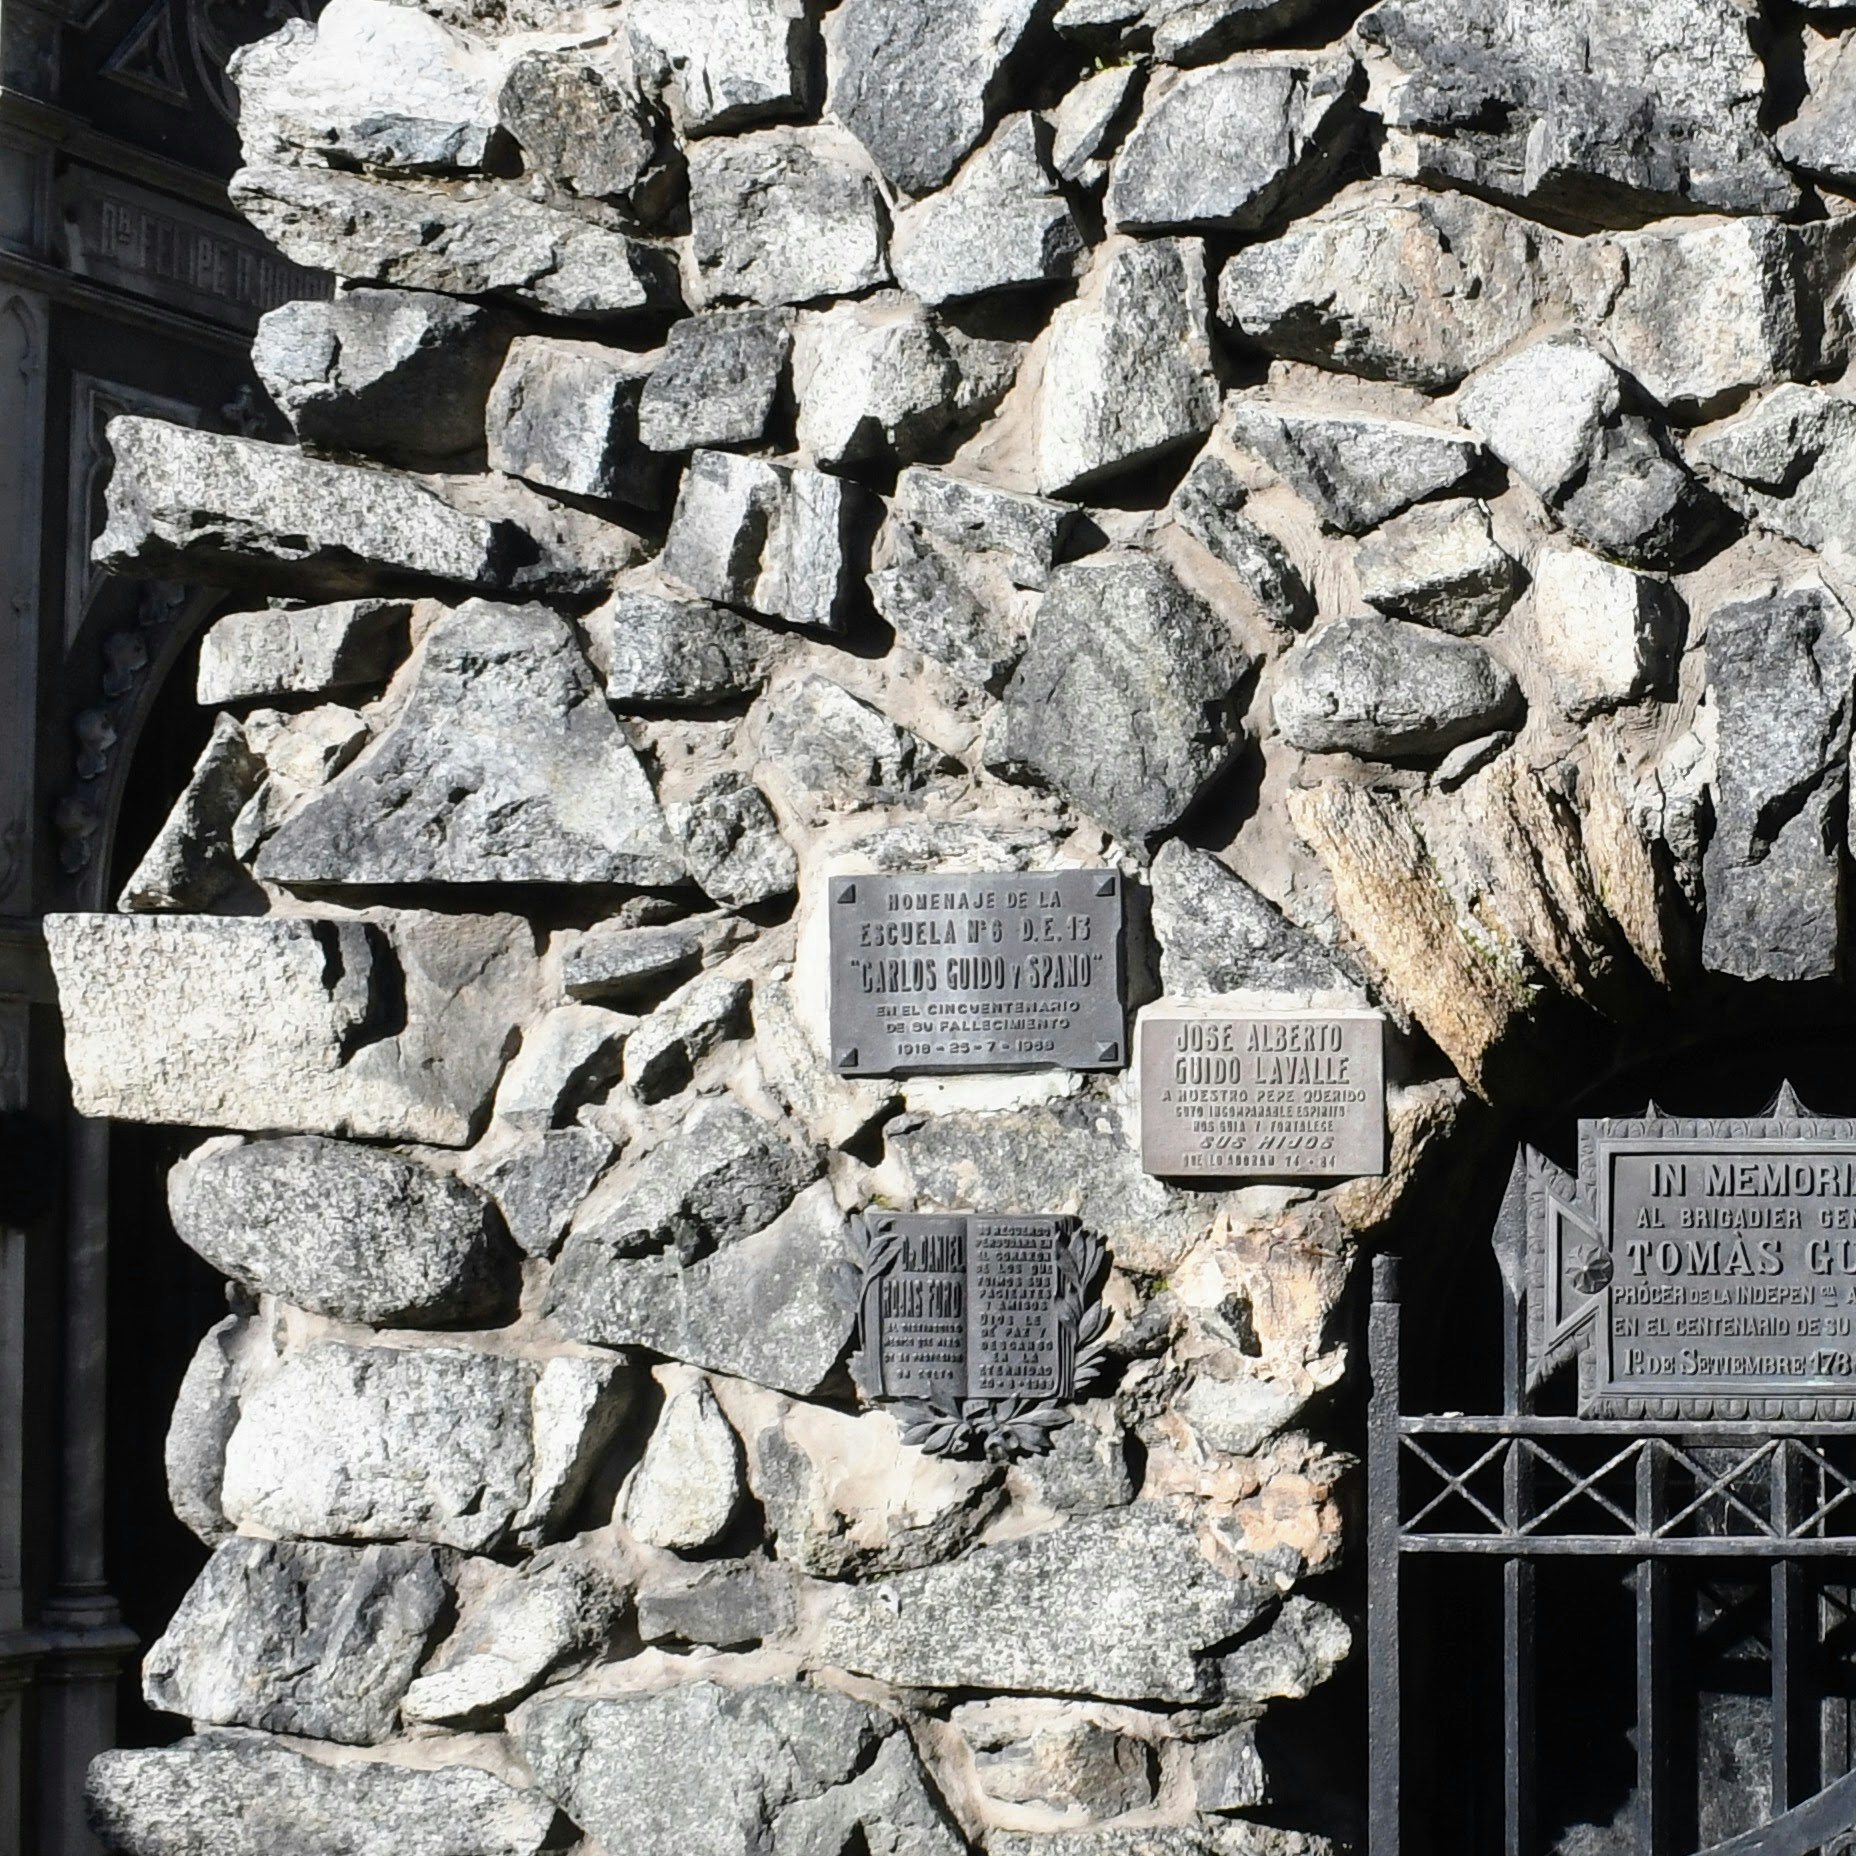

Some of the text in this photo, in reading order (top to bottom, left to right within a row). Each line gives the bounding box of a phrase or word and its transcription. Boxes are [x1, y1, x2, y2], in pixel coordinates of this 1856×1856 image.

[887, 891, 1062, 912] HOMENAJE DE LA
[859, 919, 957, 947] ESCUELA
[946, 955, 1006, 991] GUIDO
[876, 1000, 1081, 1018] EN EL CINCUENTENARIO
[886, 1017, 1071, 1034] DE SU FALLECIMIENTO
[1176, 1022, 1344, 1053] JOSE ALBERTO
[897, 1042, 931, 1056] 1918
[986, 1040, 997, 1053] 7
[1175, 1055, 1352, 1086] GUIDO LAVALLE
[1161, 1089, 1367, 1104] A NUESTRO PEPE QUERIDO
[1175, 1105, 1204, 1119] CUYO
[1209, 1105, 1294, 1119] INCOMPARABLE
[1193, 1120, 1216, 1133] NOS
[1270, 1120, 1335, 1133] FORTALECE
[1200, 1135, 1336, 1151] SUS HIJOS
[1183, 1154, 1203, 1168] QUE
[1209, 1154, 1223, 1167] LO
[1227, 1154, 1276, 1168] ADORAN
[1649, 1162, 1687, 1198] IN
[1636, 1208, 1666, 1229] AL
[1679, 1208, 1802, 1230] BRIGADIER
[920, 1234, 966, 1274] DANIEL
[1625, 1231, 1785, 1277] TOMÁS
[1031, 1263, 1053, 1276] QUE
[882, 1279, 924, 1320] ROJAS
[1613, 1279, 1687, 1306] PRÓCER
[1690, 1289, 1711, 1305] DE
[1712, 1288, 1732, 1305] LA
[1613, 1317, 1639, 1337] EN
[1646, 1317, 1670, 1337] EL
[1675, 1317, 1790, 1337] CENTENARIO
[1798, 1317, 1822, 1337] DE
[1824, 1317, 1851, 1337] SU
[1023, 1352, 1039, 1363] LA
[1646, 1356, 1677, 1376] DE
[979, 1364, 1053, 1377] ETERNIDAD
